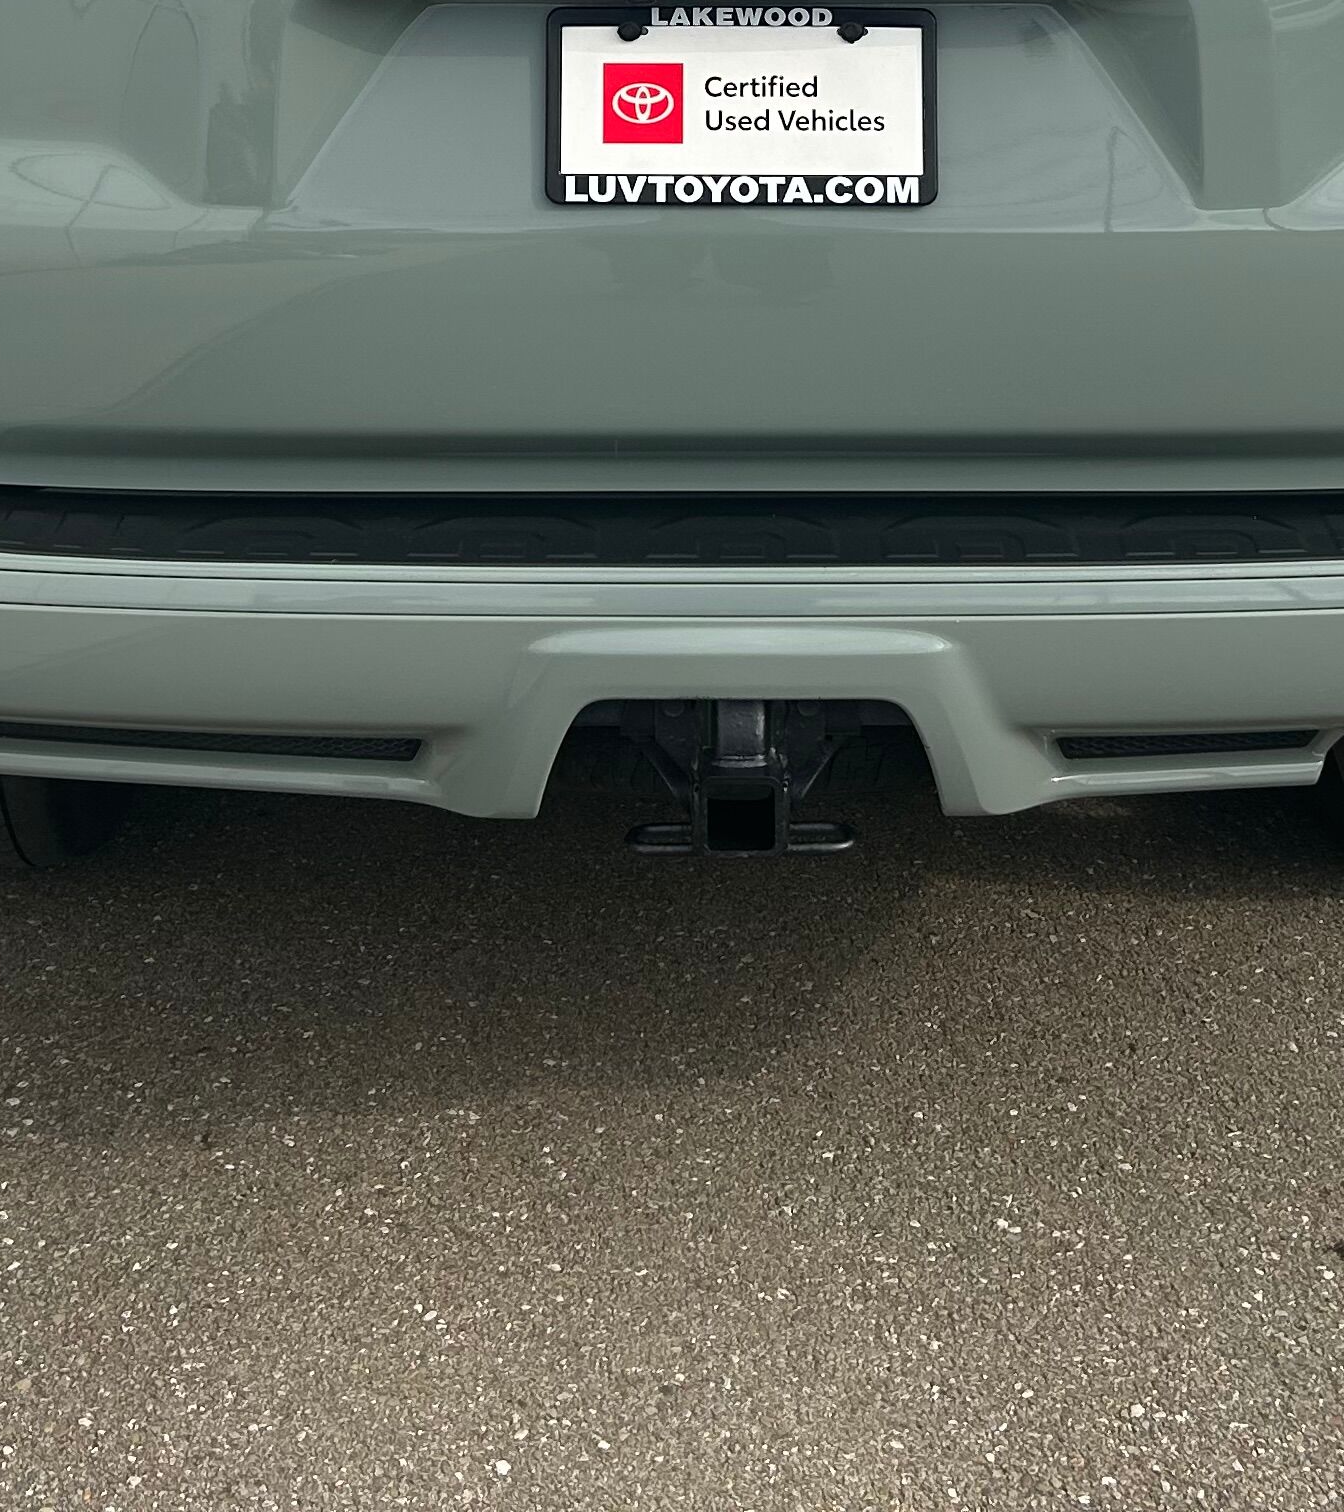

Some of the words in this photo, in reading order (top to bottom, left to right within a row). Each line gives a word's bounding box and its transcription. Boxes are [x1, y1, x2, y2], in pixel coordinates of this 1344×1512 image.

[650, 7, 833, 27] LAKEWOOD
[704, 76, 818, 98] Certified
[704, 111, 770, 133] Used
[778, 109, 886, 133] Vehicles
[563, 176, 921, 205] LUVTOYOTA.COM
